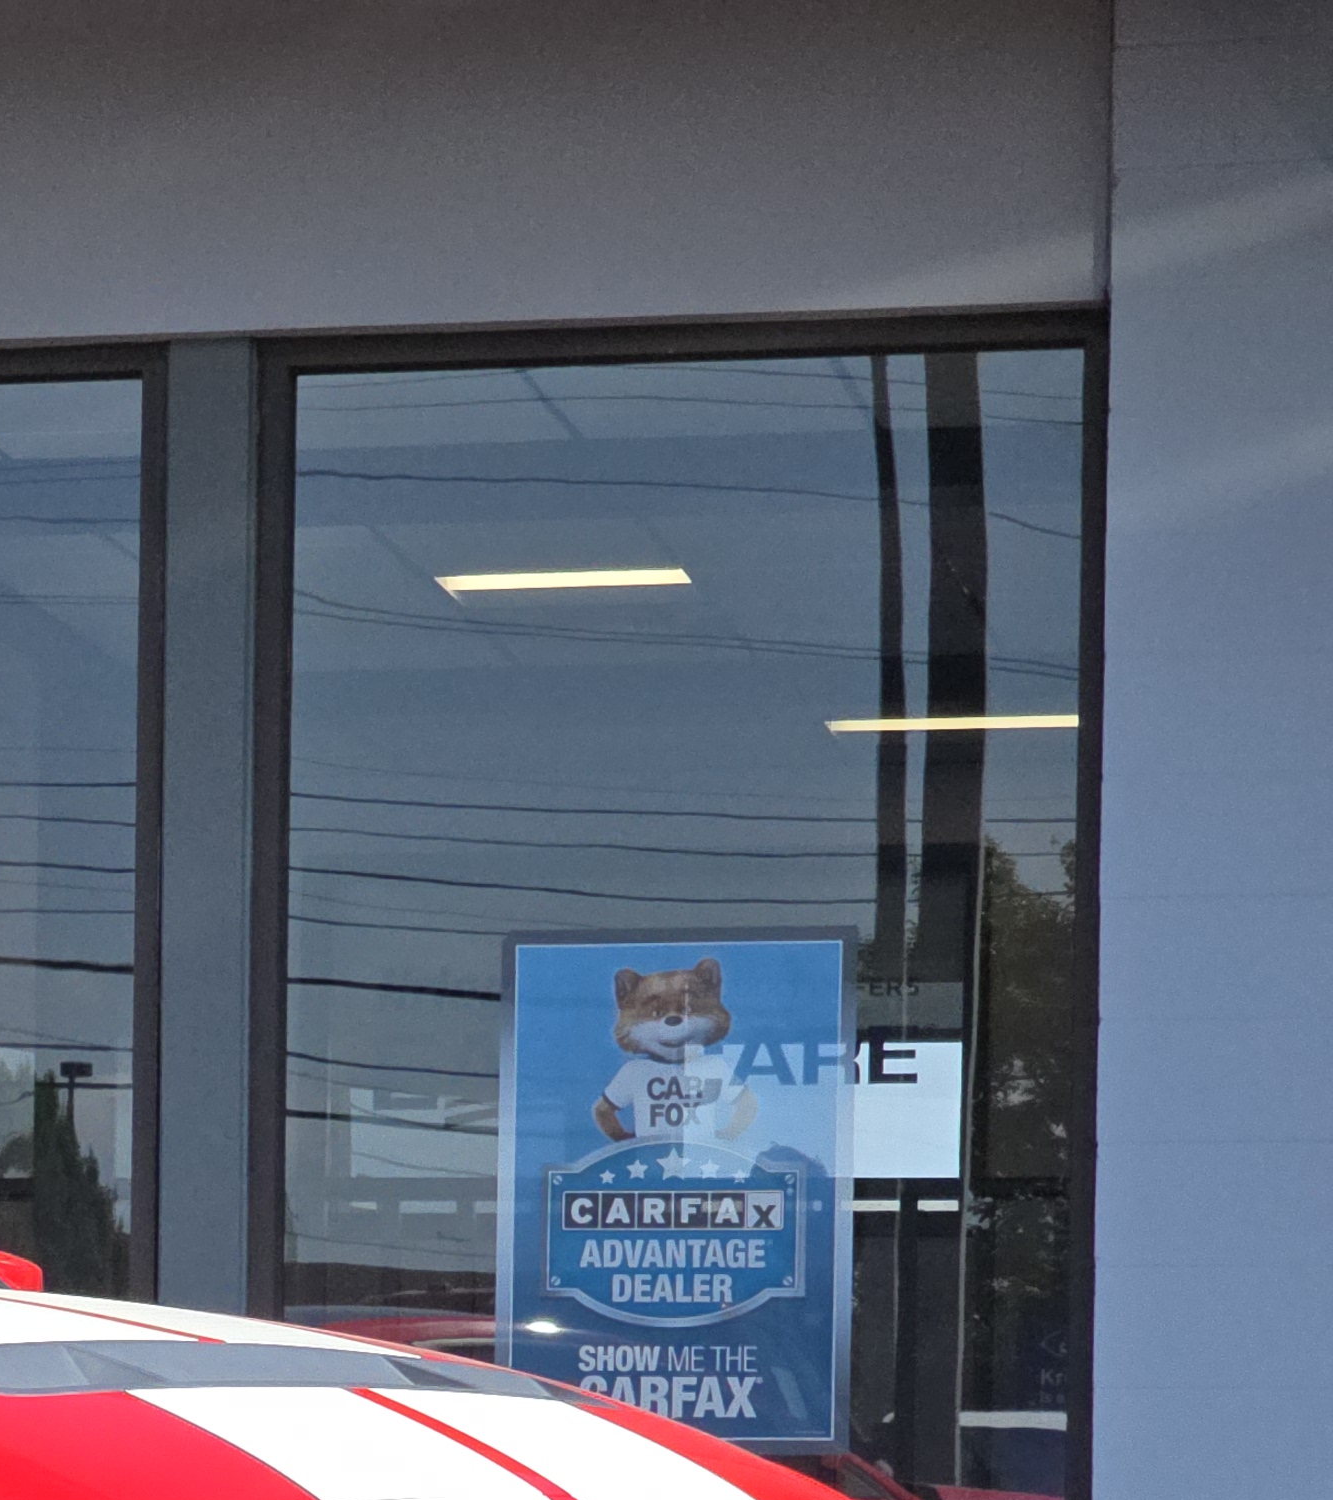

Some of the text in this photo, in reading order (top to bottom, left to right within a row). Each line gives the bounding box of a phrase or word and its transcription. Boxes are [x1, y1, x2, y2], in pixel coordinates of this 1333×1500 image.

[647, 1076, 703, 1100] CAR
[649, 1102, 701, 1128] FOX
[570, 1197, 777, 1228] CARFAX
[580, 1239, 766, 1268] ADVANTAGE
[611, 1273, 733, 1303] DEALER
[578, 1345, 758, 1372] SHOW ME THE
